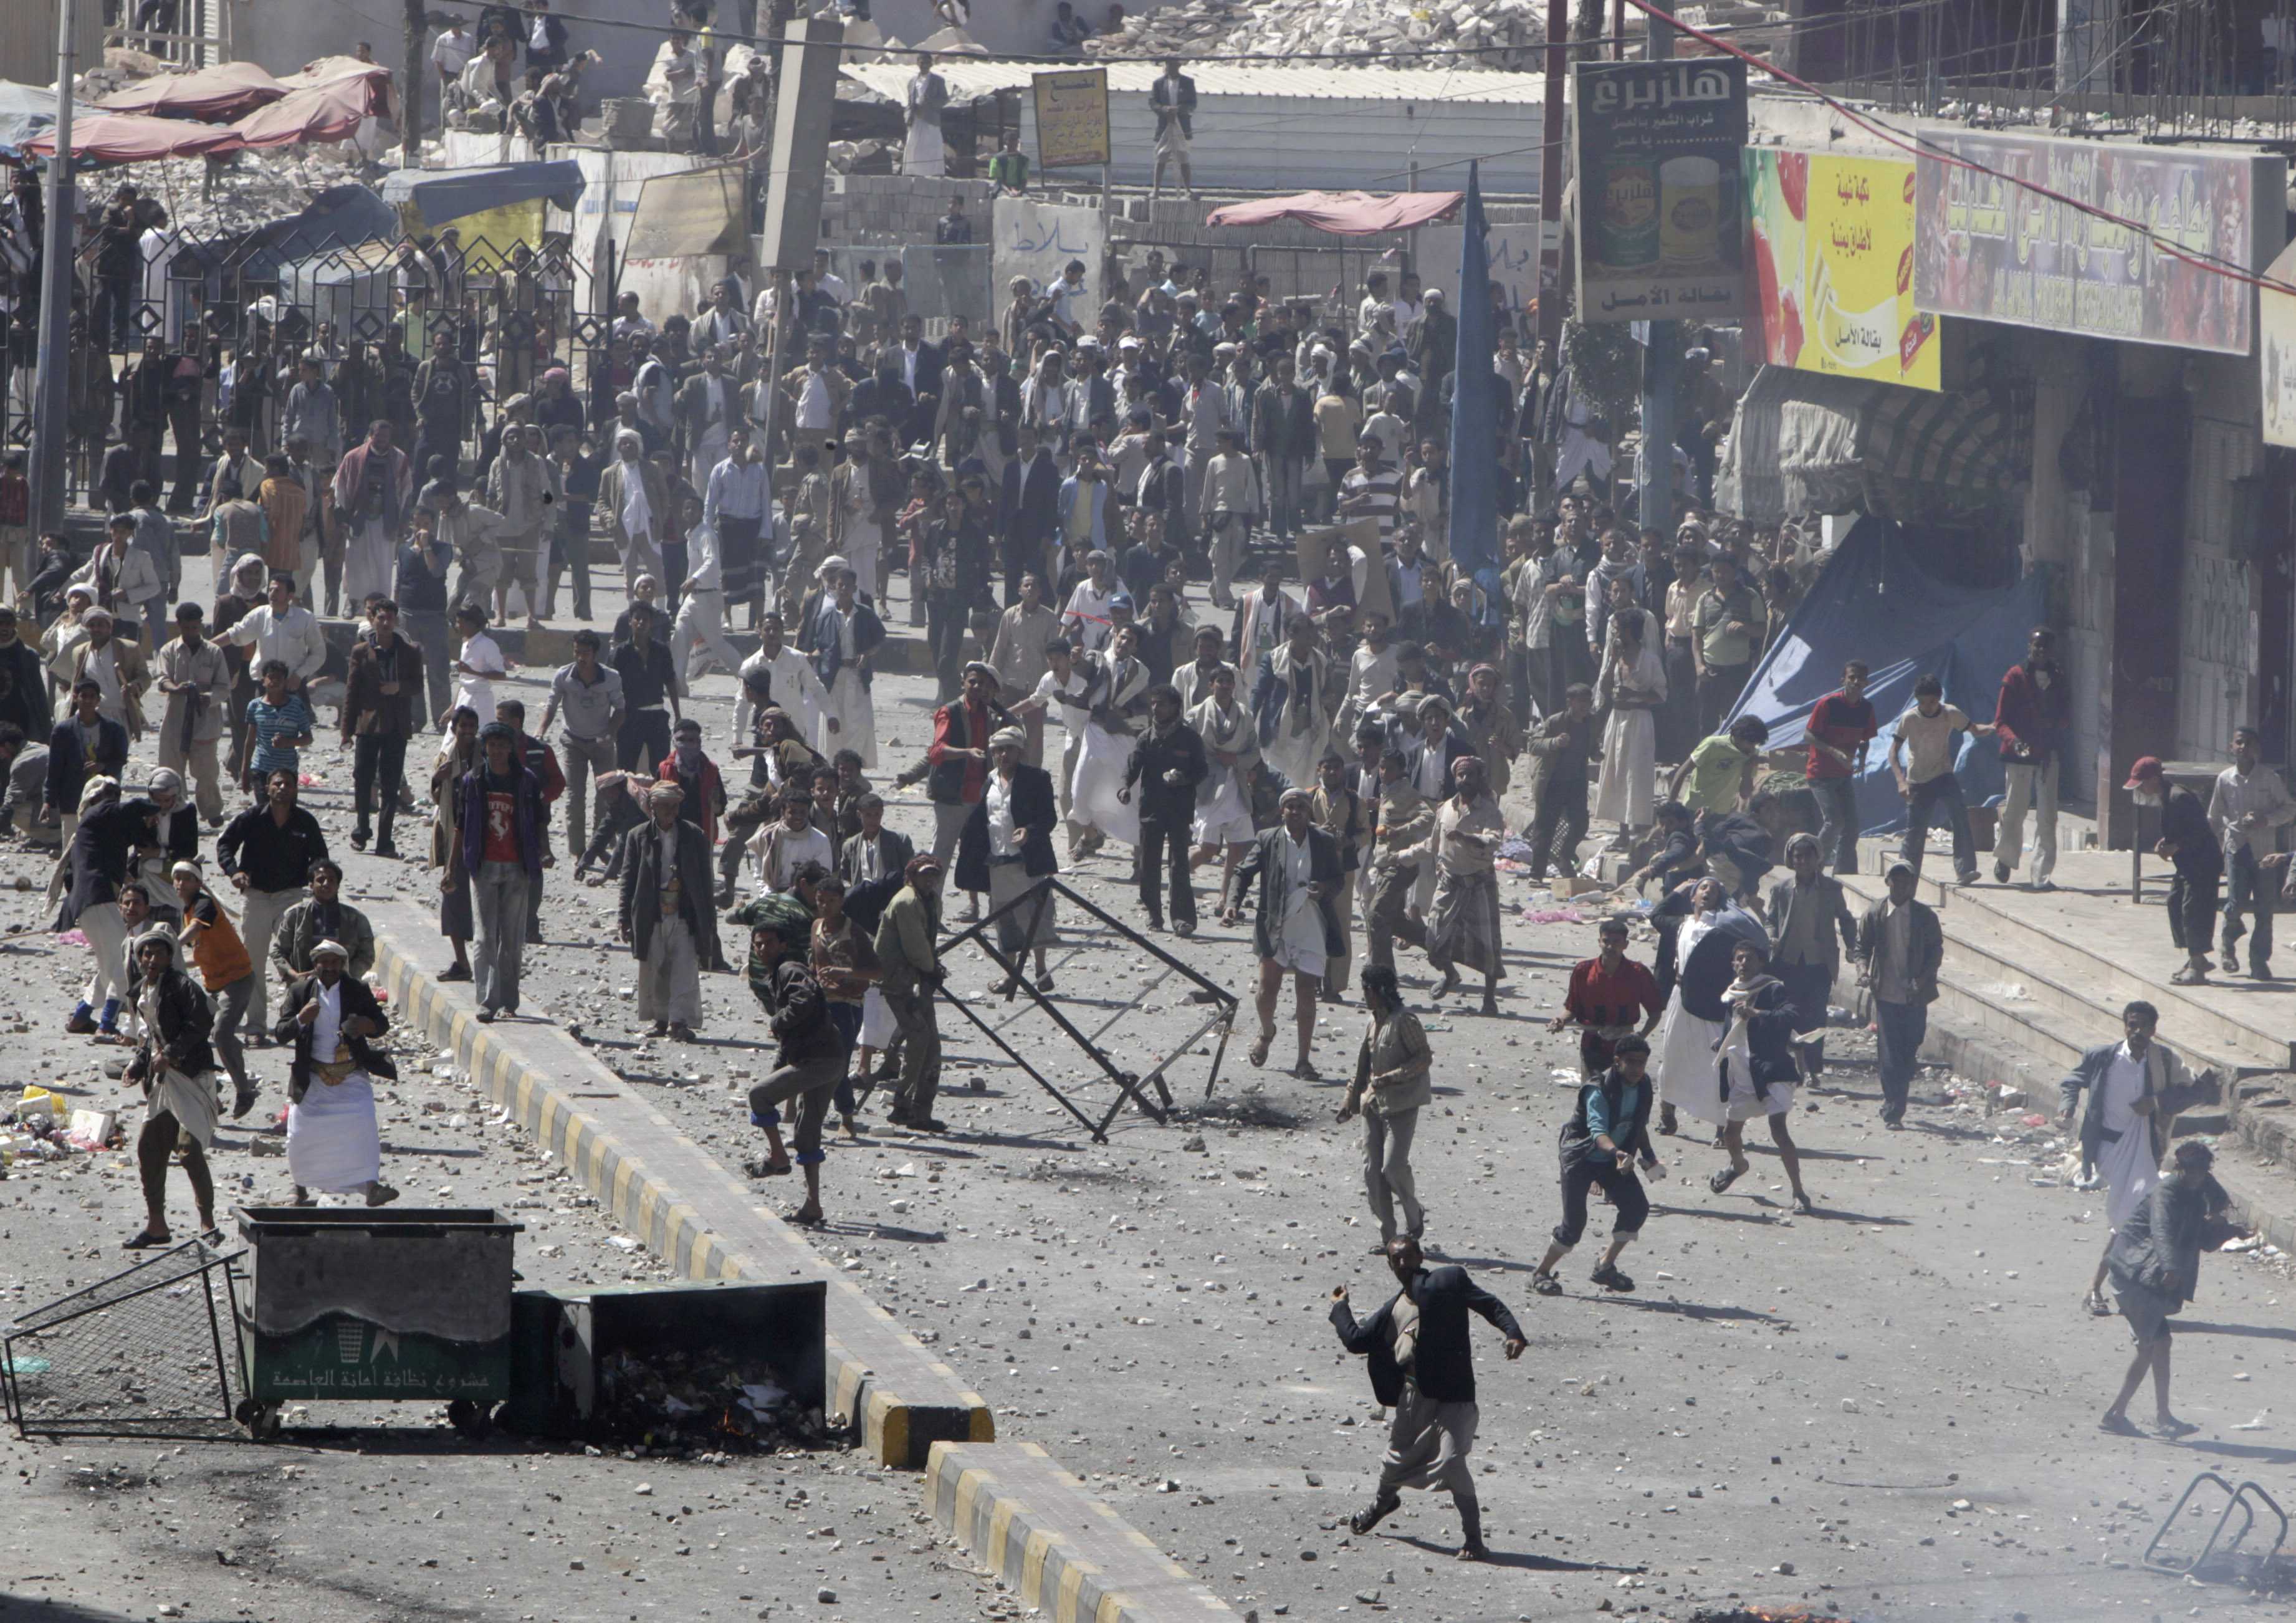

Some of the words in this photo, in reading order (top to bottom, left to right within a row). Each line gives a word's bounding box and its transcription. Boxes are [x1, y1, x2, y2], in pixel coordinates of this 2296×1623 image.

[1835, 322, 1860, 347] الأمل
[1860, 327, 1882, 354] بقالة
[272, 1369, 335, 1387] العاصمة
[383, 1367, 428, 1389] نظافة
[433, 1372, 490, 1393] مشروع
